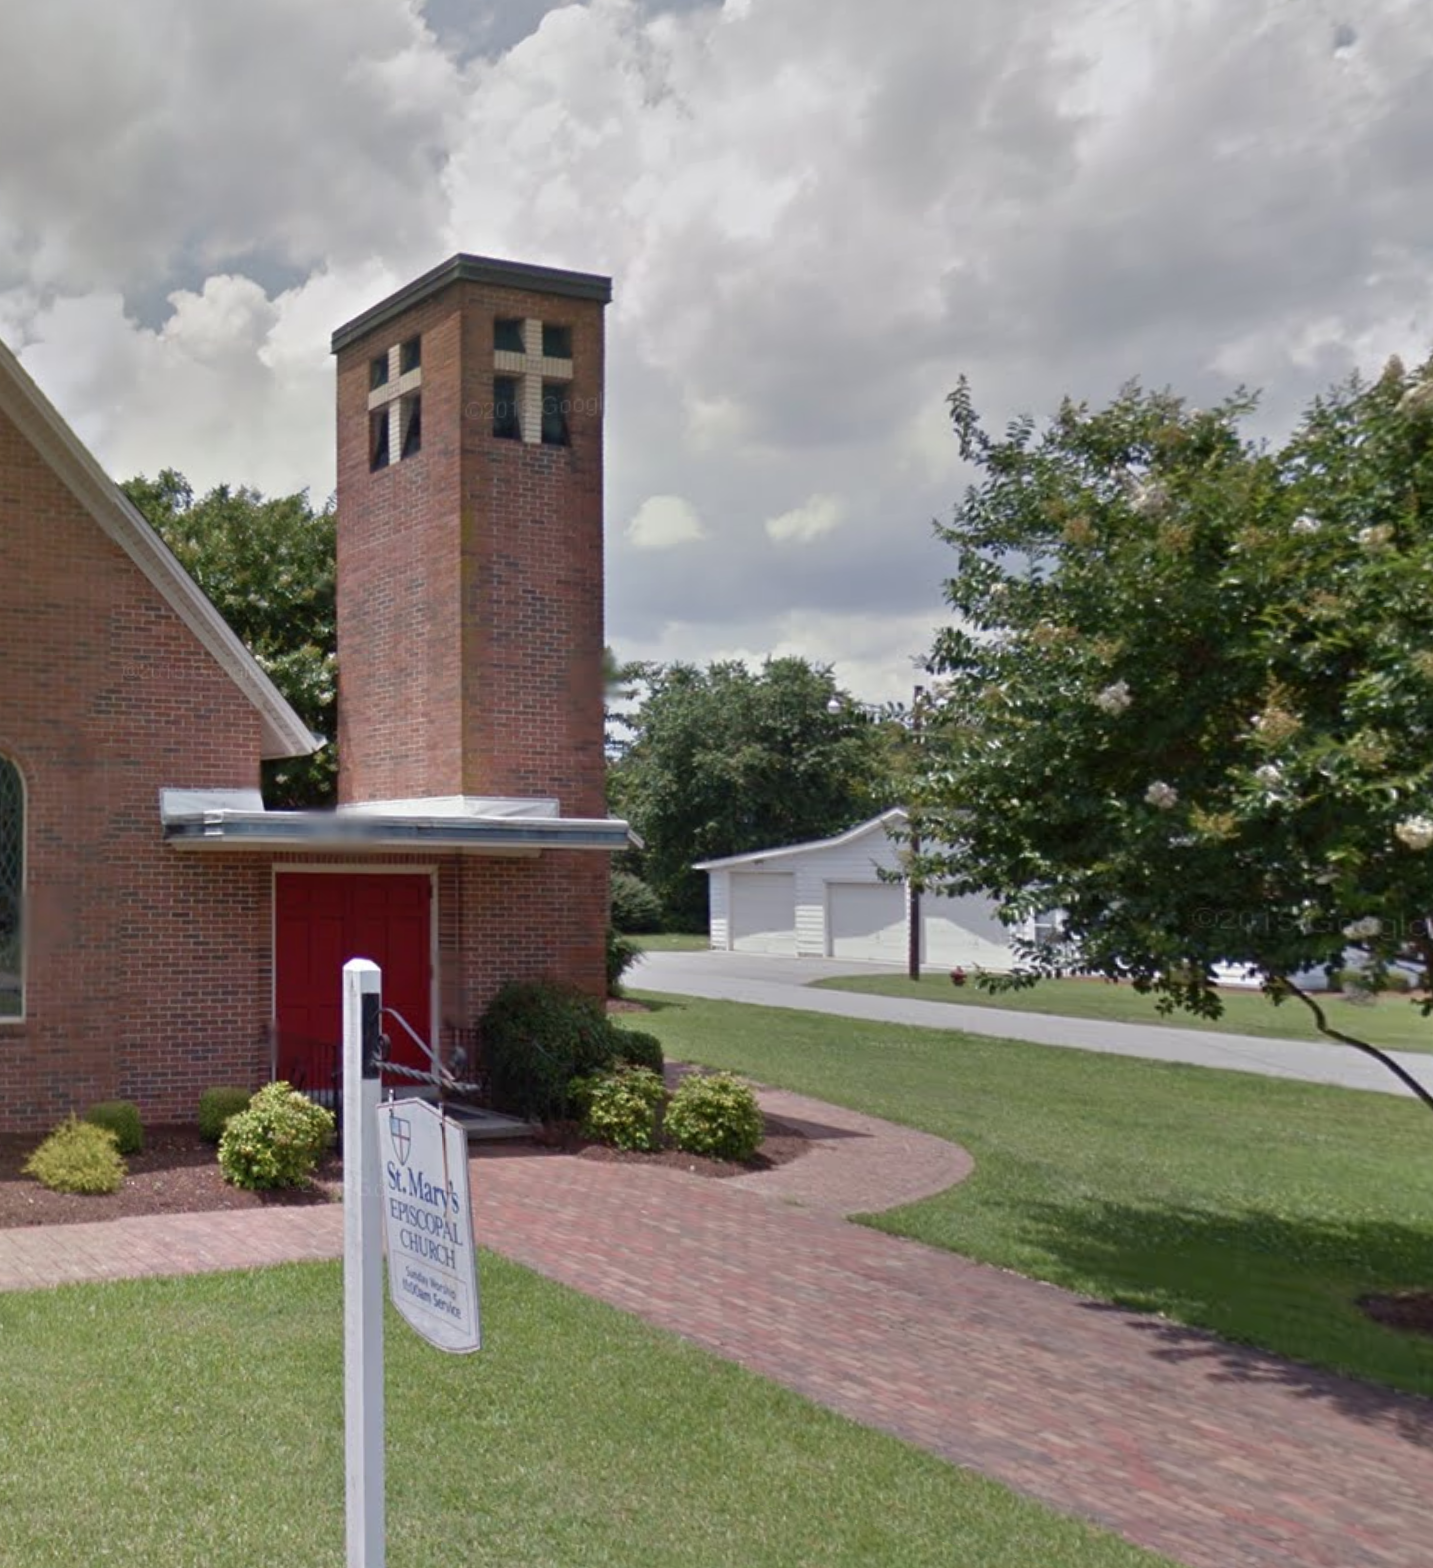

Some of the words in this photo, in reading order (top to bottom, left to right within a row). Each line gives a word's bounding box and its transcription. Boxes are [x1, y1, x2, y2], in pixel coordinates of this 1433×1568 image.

[387, 1160, 407, 1194] St.
[407, 1166, 461, 1218] Mary's
[389, 1197, 464, 1247] EPISCOPAL
[400, 1228, 456, 1270] CHURCH
[433, 1292, 462, 1320] Service
